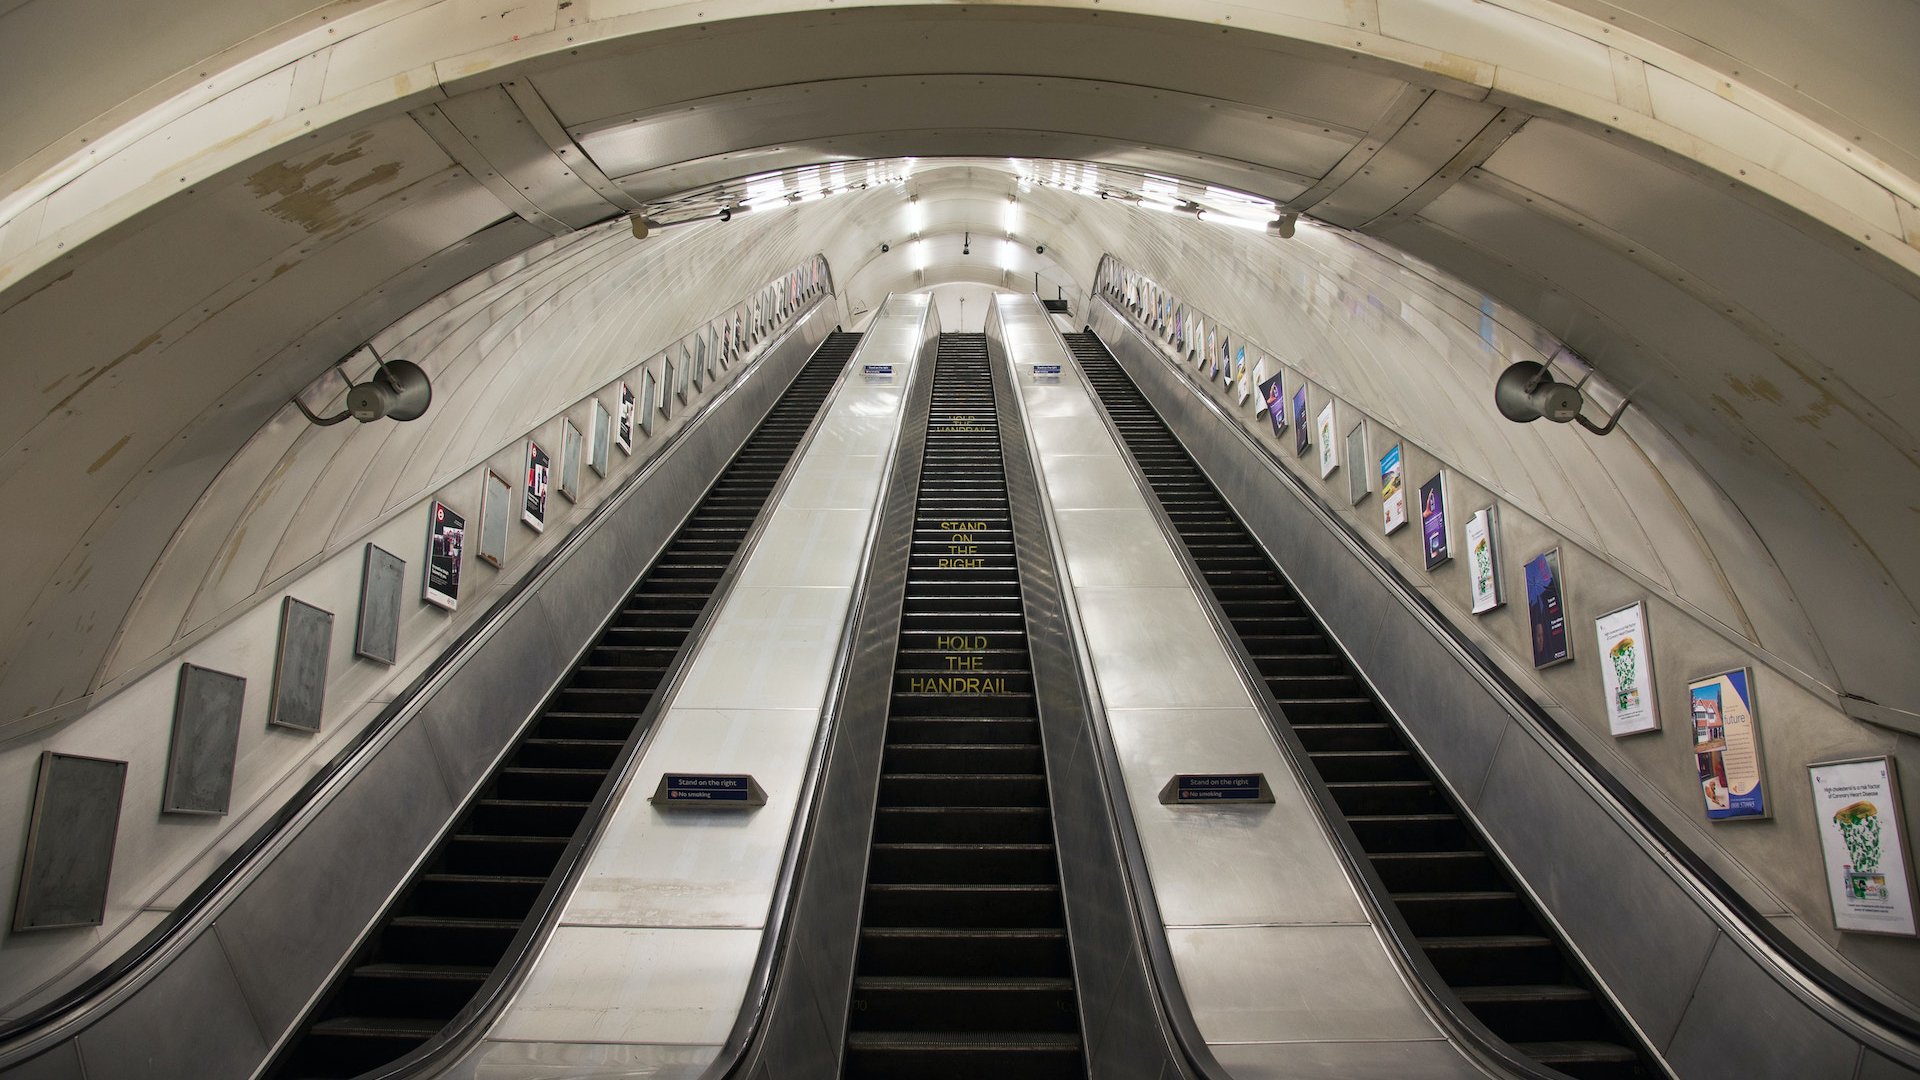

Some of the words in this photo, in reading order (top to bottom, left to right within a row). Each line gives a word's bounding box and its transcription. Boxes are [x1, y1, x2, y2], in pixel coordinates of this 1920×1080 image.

[940, 521, 988, 531] STAND
[952, 533, 973, 543] ON
[948, 545, 977, 555] THE
[938, 558, 985, 568] RIGHT
[937, 636, 987, 650] HOLD
[945, 656, 983, 671] THE
[910, 677, 1009, 694] HANDRAIL
[688, 791, 711, 799] smoking
